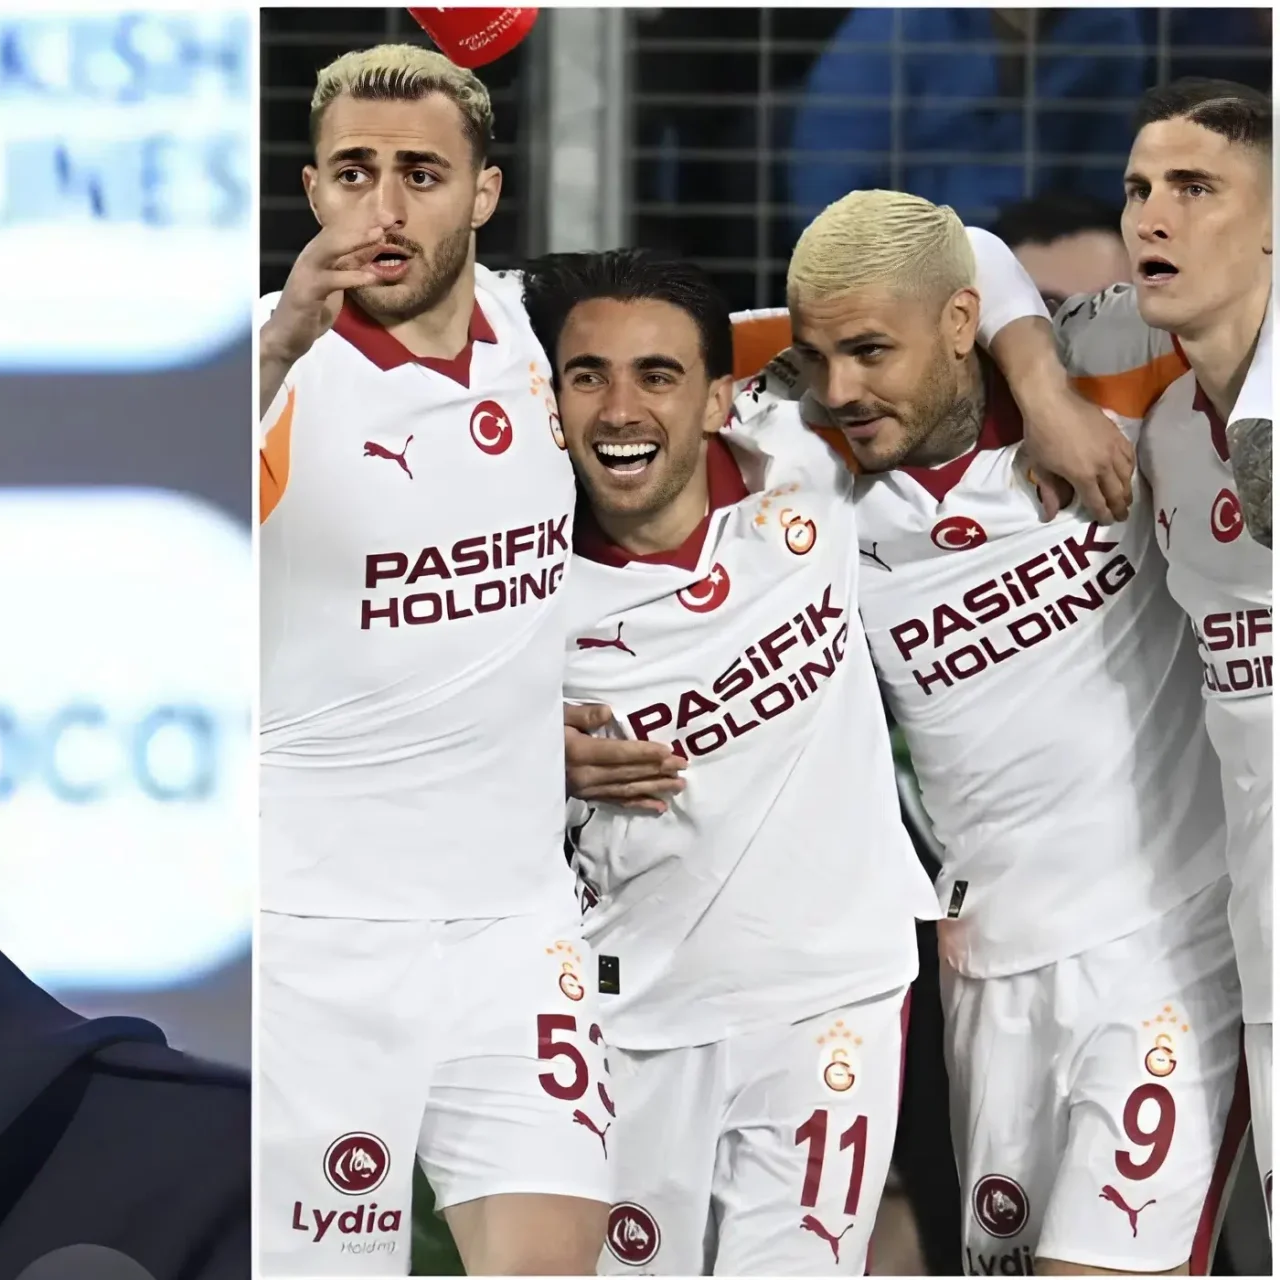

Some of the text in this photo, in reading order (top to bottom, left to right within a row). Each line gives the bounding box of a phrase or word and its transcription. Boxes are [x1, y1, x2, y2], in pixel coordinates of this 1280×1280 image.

[795, 1108, 869, 1216] 11
[1114, 1082, 1177, 1181] 9
[292, 1200, 402, 1242] Lydia
